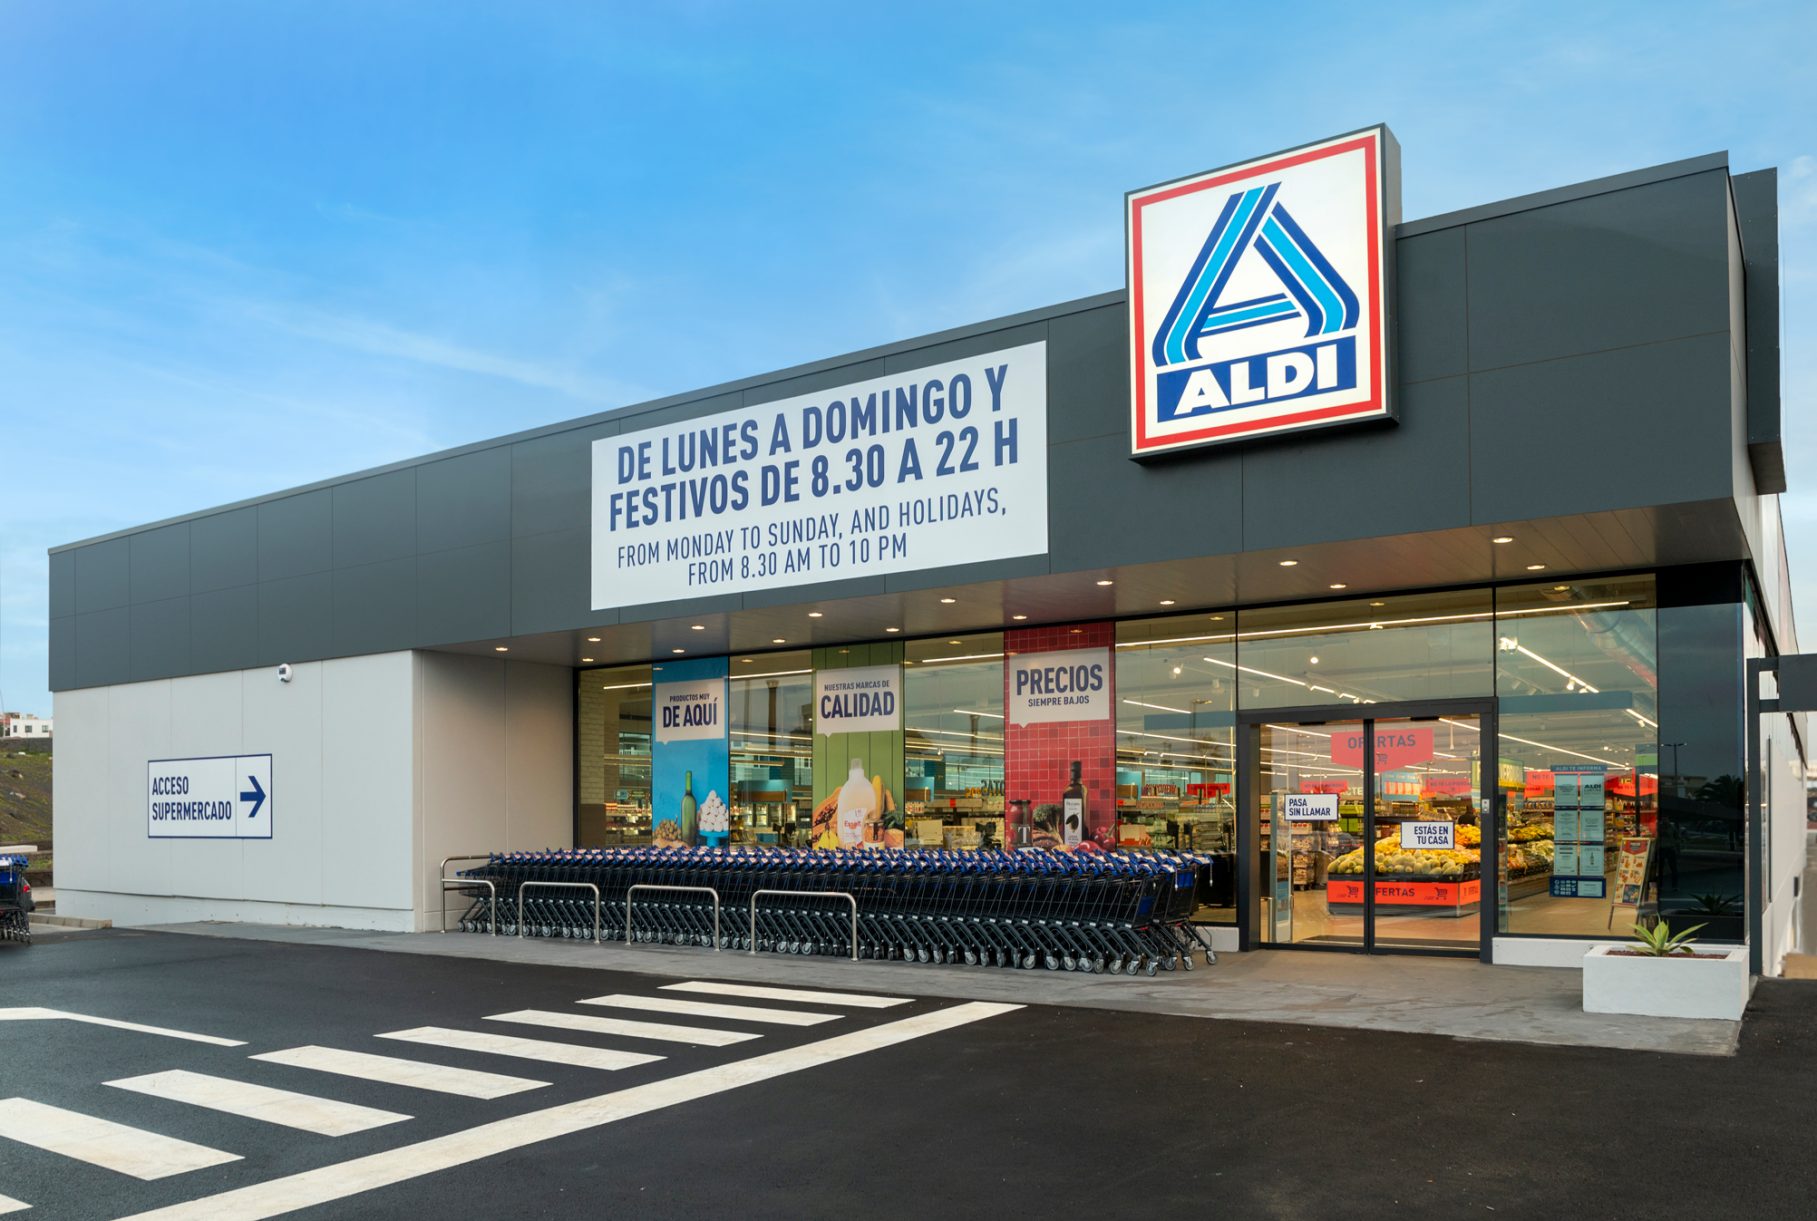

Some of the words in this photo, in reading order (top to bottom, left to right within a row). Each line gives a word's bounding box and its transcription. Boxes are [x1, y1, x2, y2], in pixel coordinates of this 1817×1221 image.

[1174, 343, 1338, 416] ALDI
[618, 441, 651, 484] DE
[662, 419, 758, 475] LUNES
[770, 413, 791, 456] A
[803, 374, 972, 450] DOMINGO
[984, 364, 1008, 412] Y
[610, 470, 749, 531] FESTIVOS
[761, 460, 800, 506] DE
[812, 443, 885, 498] 8.30
[897, 438, 922, 483] A
[936, 425, 979, 477] 22
[995, 418, 1018, 466] H
[618, 542, 660, 568] FROM
[666, 530, 733, 561] MONDAY
[740, 526, 761, 550] TO
[768, 513, 843, 546] SUNDAY,
[852, 506, 890, 533] AND
[899, 488, 1006, 527] HOLIDAYS,
[688, 558, 733, 586] FROM
[742, 552, 777, 578] 8.30
[784, 547, 811, 573] AM
[819, 544, 840, 568] TO
[850, 541, 870, 565] 10
[879, 533, 907, 560] PM
[824, 683, 854, 691] NUESTRAS
[856, 681, 880, 689] MARCAS
[1017, 664, 1103, 695] PRECIOS
[670, 694, 698, 703] PRODUCTOS
[821, 691, 894, 719] CALIDAD
[1028, 697, 1062, 707] SIEMPRE
[1064, 696, 1089, 705] BAJOS
[663, 706, 680, 728] DE
[683, 697, 717, 726] AQUÍ
[1348, 734, 1416, 749] OFRTAS
[152, 776, 189, 795] ACCESO
[152, 801, 231, 821] SUPERMERCADO
[1289, 798, 1307, 808] PASA
[1289, 807, 1301, 816] SIN
[1303, 807, 1331, 816] LLAMAR
[1413, 825, 1436, 835] ESTÁS
[1439, 826, 1448, 835] EN
[1417, 836, 1427, 845] TU
[1429, 835, 1448, 845] CASA
[1375, 888, 1415, 896] FERTAS
